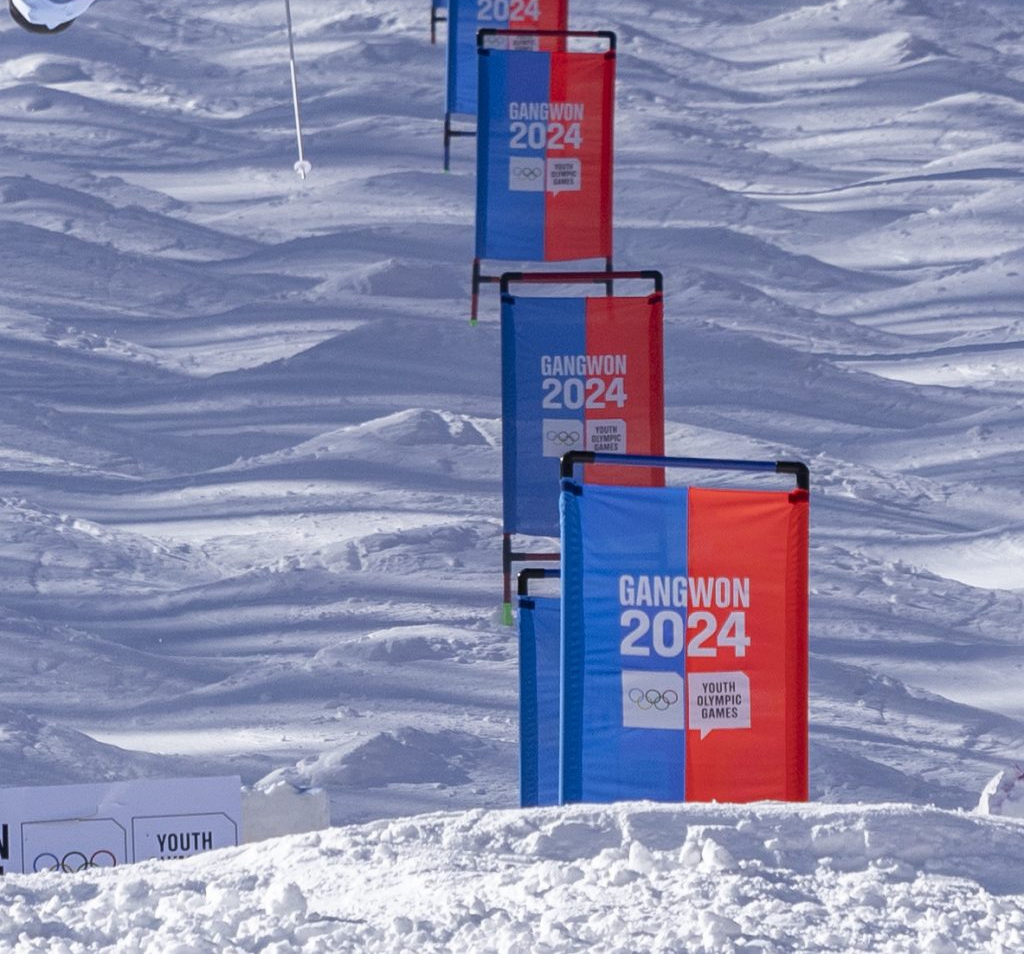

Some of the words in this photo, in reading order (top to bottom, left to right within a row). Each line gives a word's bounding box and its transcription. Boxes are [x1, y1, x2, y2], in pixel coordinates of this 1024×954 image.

[509, 102, 584, 120] GANGWON
[510, 121, 582, 149] 2024
[541, 354, 627, 376] GANGWON
[542, 377, 627, 409] 2024
[591, 434, 621, 442] OLYMPIC
[595, 426, 617, 434] YOUTH
[594, 443, 618, 451] GAMES
[619, 574, 750, 608] GANGWON
[620, 609, 751, 658] 2024
[702, 681, 736, 694] YOUTH
[696, 694, 742, 707] OLYMPIC
[701, 707, 738, 719] GAMES
[157, 831, 213, 852] YOUTH
